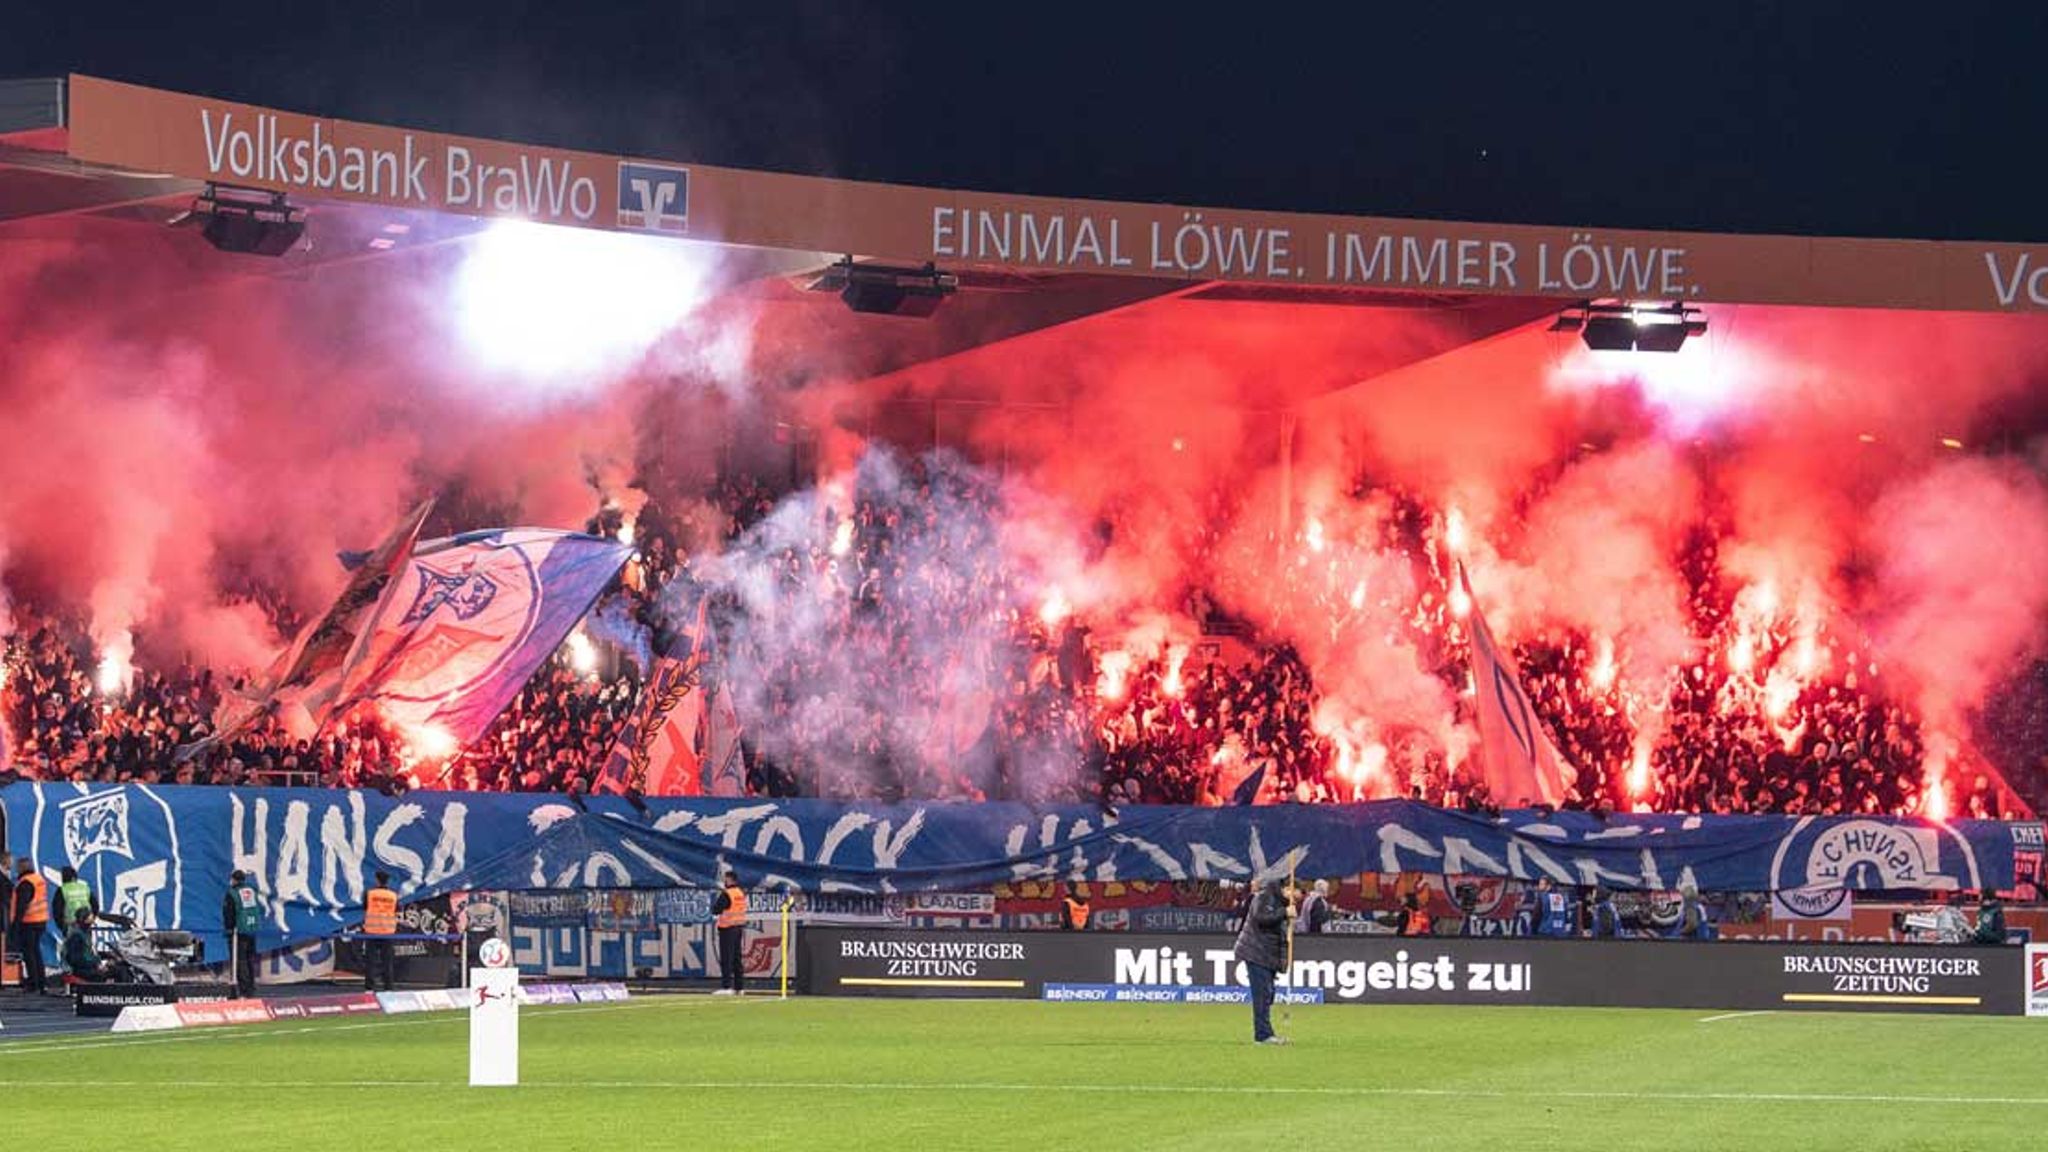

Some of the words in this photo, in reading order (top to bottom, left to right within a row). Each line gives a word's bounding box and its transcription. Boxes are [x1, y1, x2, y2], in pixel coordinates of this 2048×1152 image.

[201, 109, 428, 203] Volksbank
[446, 146, 598, 220] BraWo
[932, 206, 1132, 266] EINMAL
[1150, 212, 1305, 276] LÖWE.
[1326, 233, 1516, 288] IMMER
[1538, 233, 1701, 294] LÖWE.
[231, 790, 468, 933] HANSA
[917, 895, 982, 911] LAAGE
[1145, 911, 1225, 928] SCHWERIN
[841, 941, 1025, 959] BRAUNSCHWEIGER
[887, 960, 977, 976] ZEITUNG
[1115, 946, 1192, 985] Mit
[1205, 949, 1455, 997] Temgeist
[1783, 956, 1981, 975] BRAUNSCHWEIGER
[1833, 975, 1930, 992] ZEITUNG
